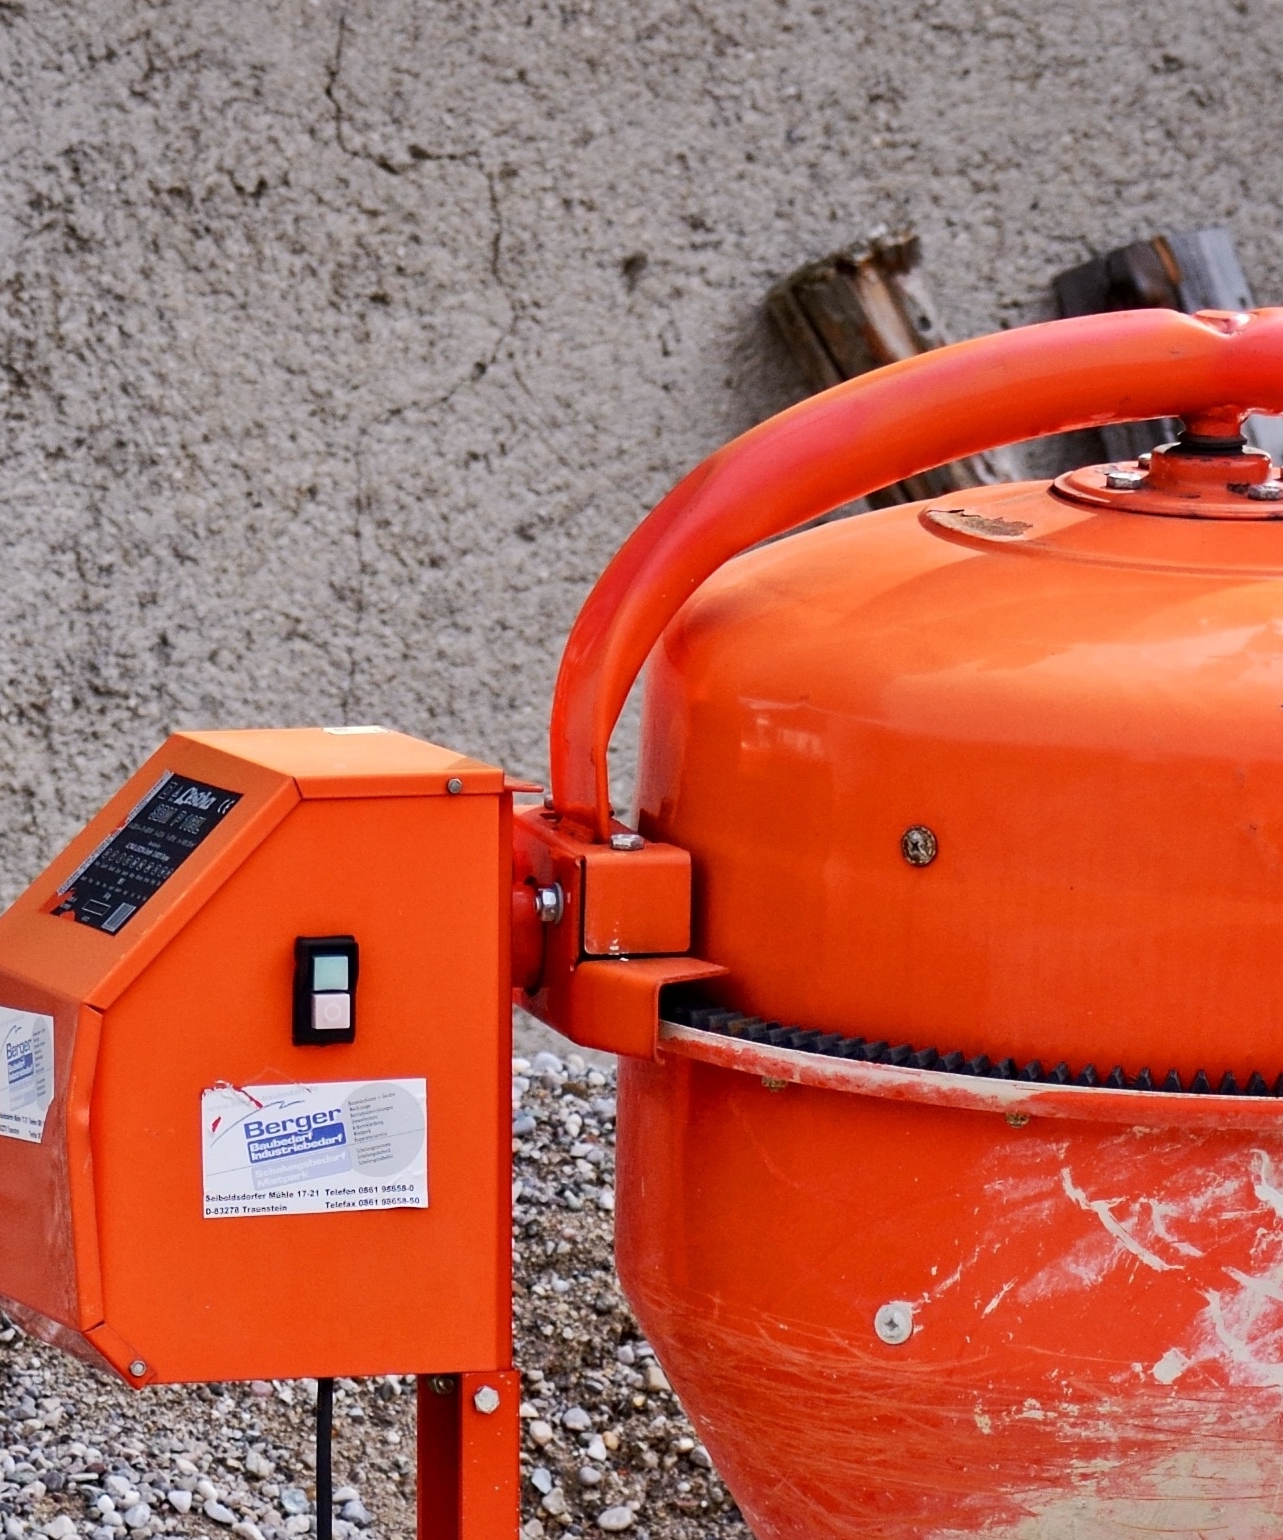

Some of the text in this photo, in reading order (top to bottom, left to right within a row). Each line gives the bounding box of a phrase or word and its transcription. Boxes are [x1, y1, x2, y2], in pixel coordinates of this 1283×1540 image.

[244, 1108, 341, 1139] Berger
[250, 1131, 313, 1152] Baubedarf
[251, 1133, 343, 1160] Industriebedarf
[255, 1152, 346, 1177] Schalungsbedarf
[257, 1171, 309, 1189] Mietpark
[268, 1191, 294, 1199] Mühle
[297, 1189, 320, 1197] 17-21
[325, 1188, 356, 1196] Telefon
[242, 1204, 287, 1213] Traunstein
[325, 1200, 356, 1209] Telefax
